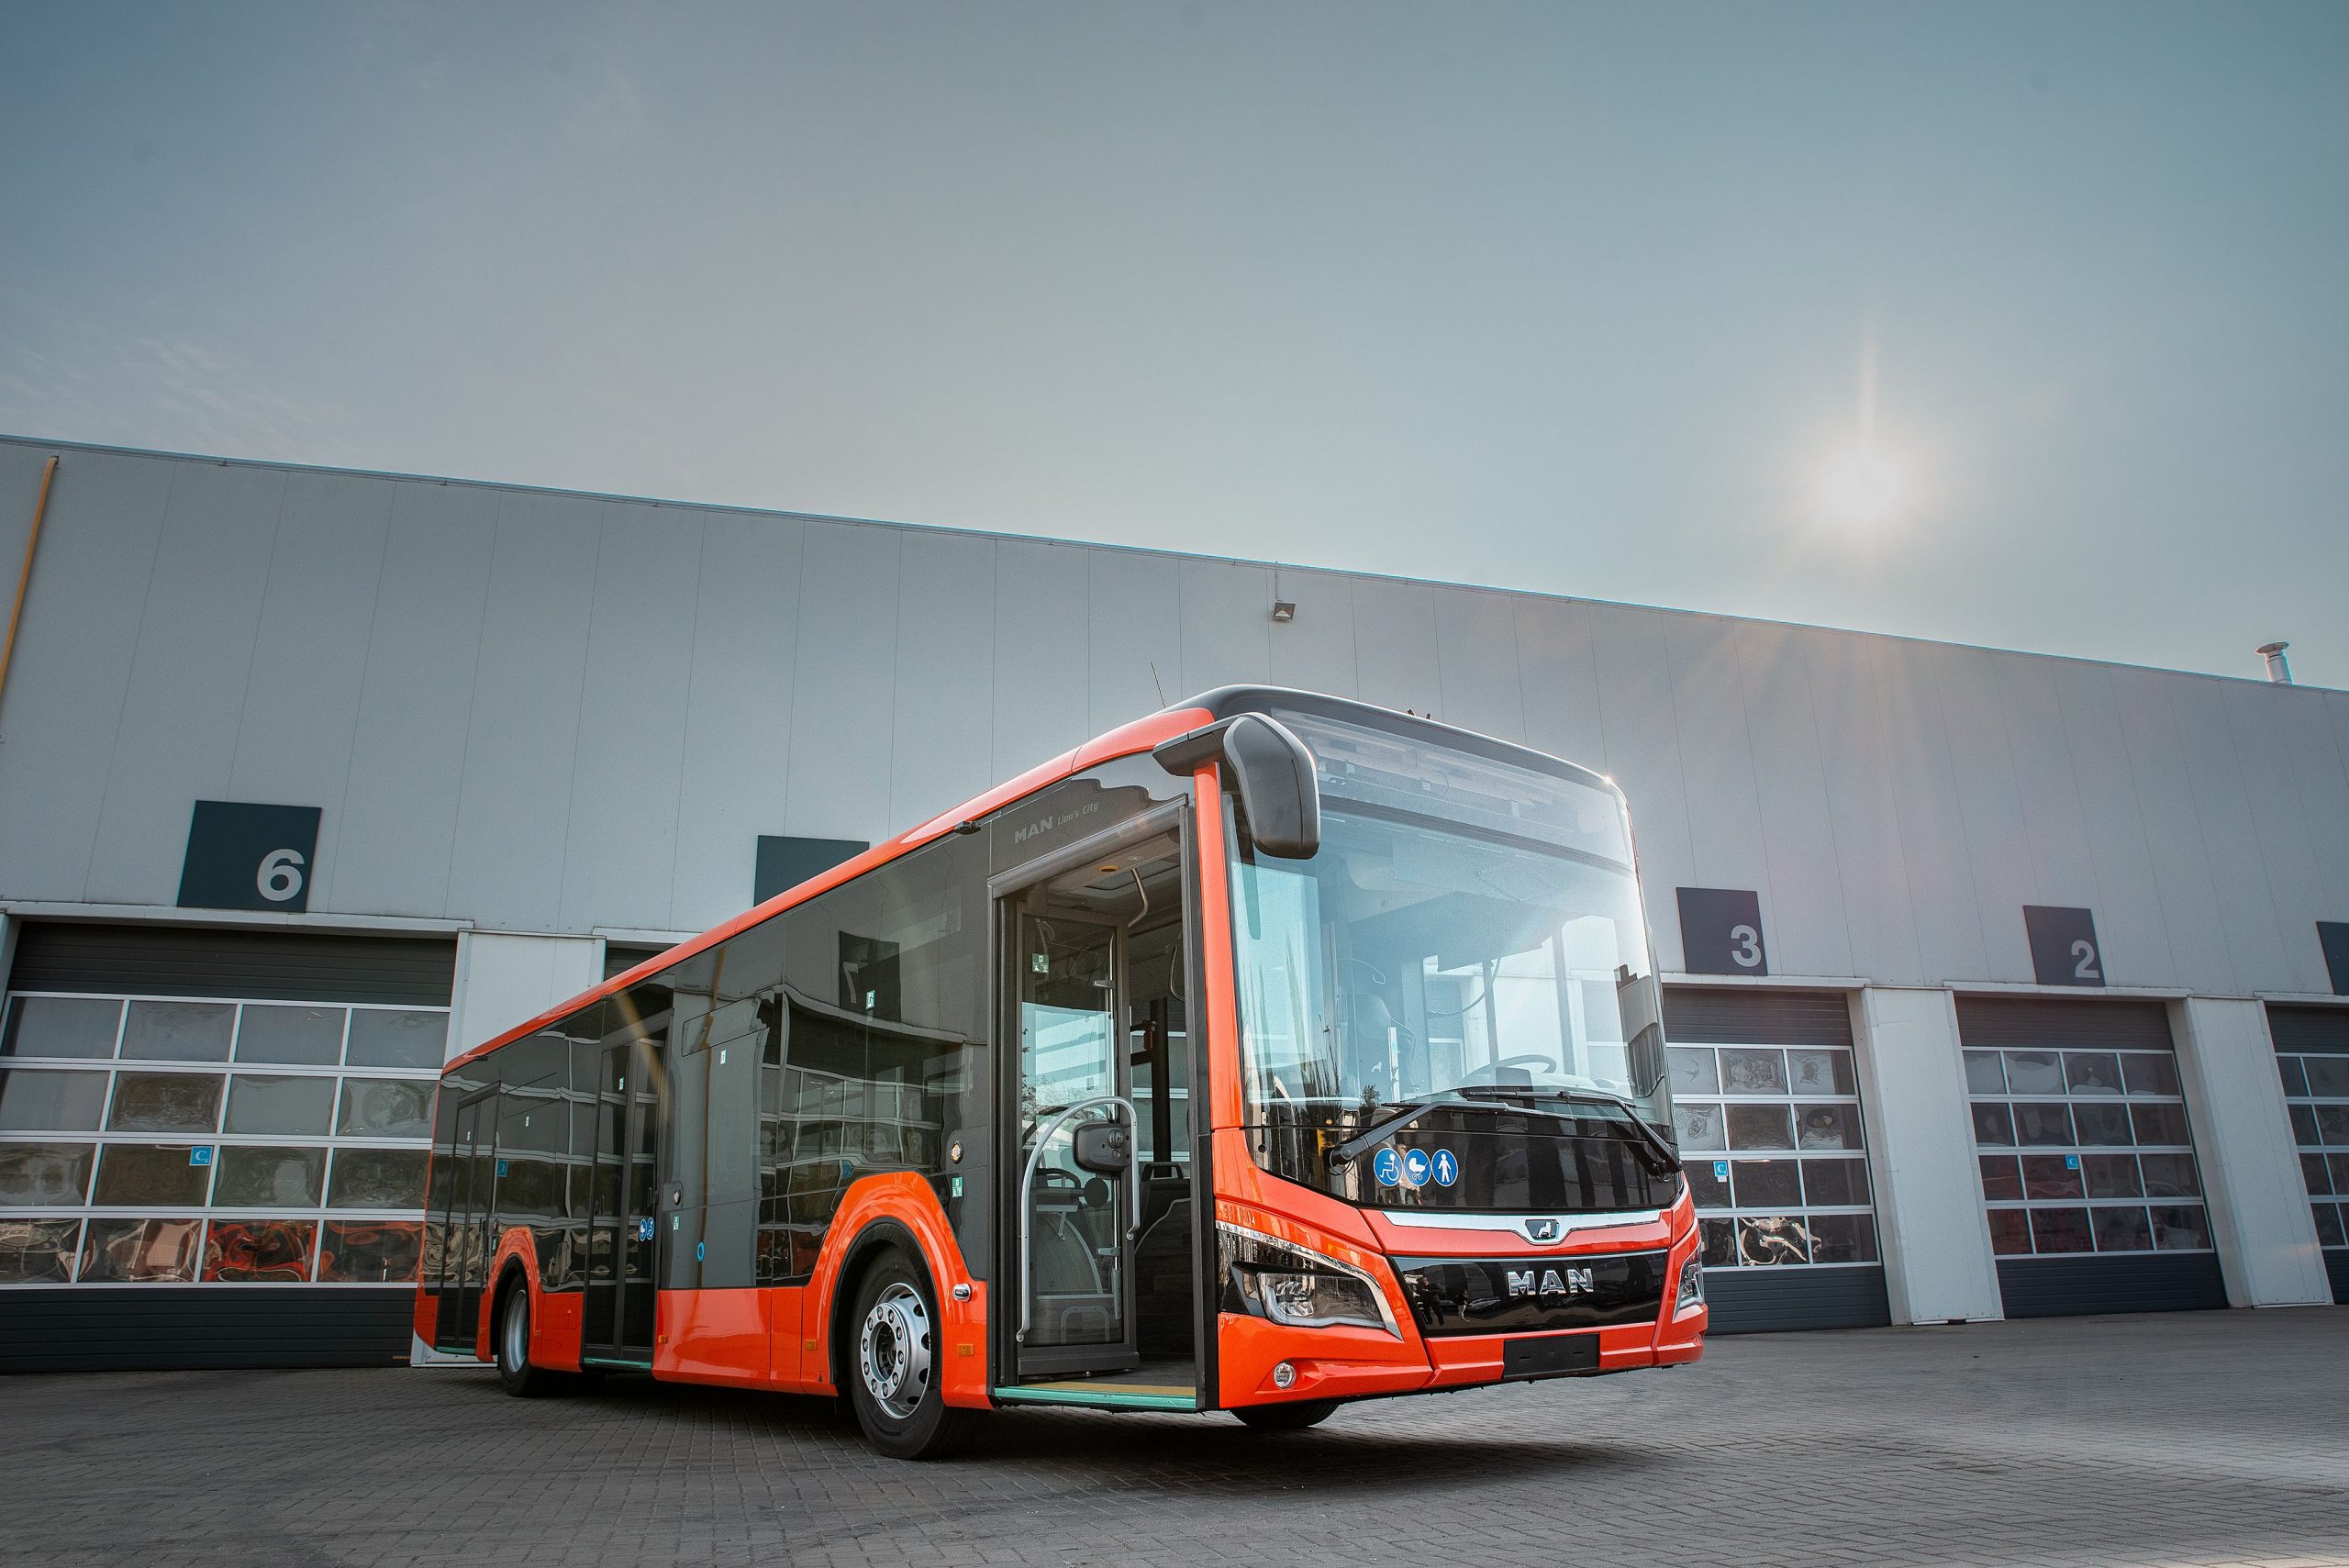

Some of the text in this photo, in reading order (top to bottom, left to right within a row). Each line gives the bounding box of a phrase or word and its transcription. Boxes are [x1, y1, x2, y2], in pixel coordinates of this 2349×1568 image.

[1014, 801, 1099, 844] MAN Lion's City
[257, 848, 305, 902] 6
[1731, 924, 1762, 968] 3
[2071, 940, 2100, 979] 2
[1506, 1268, 1595, 1296] MAN
